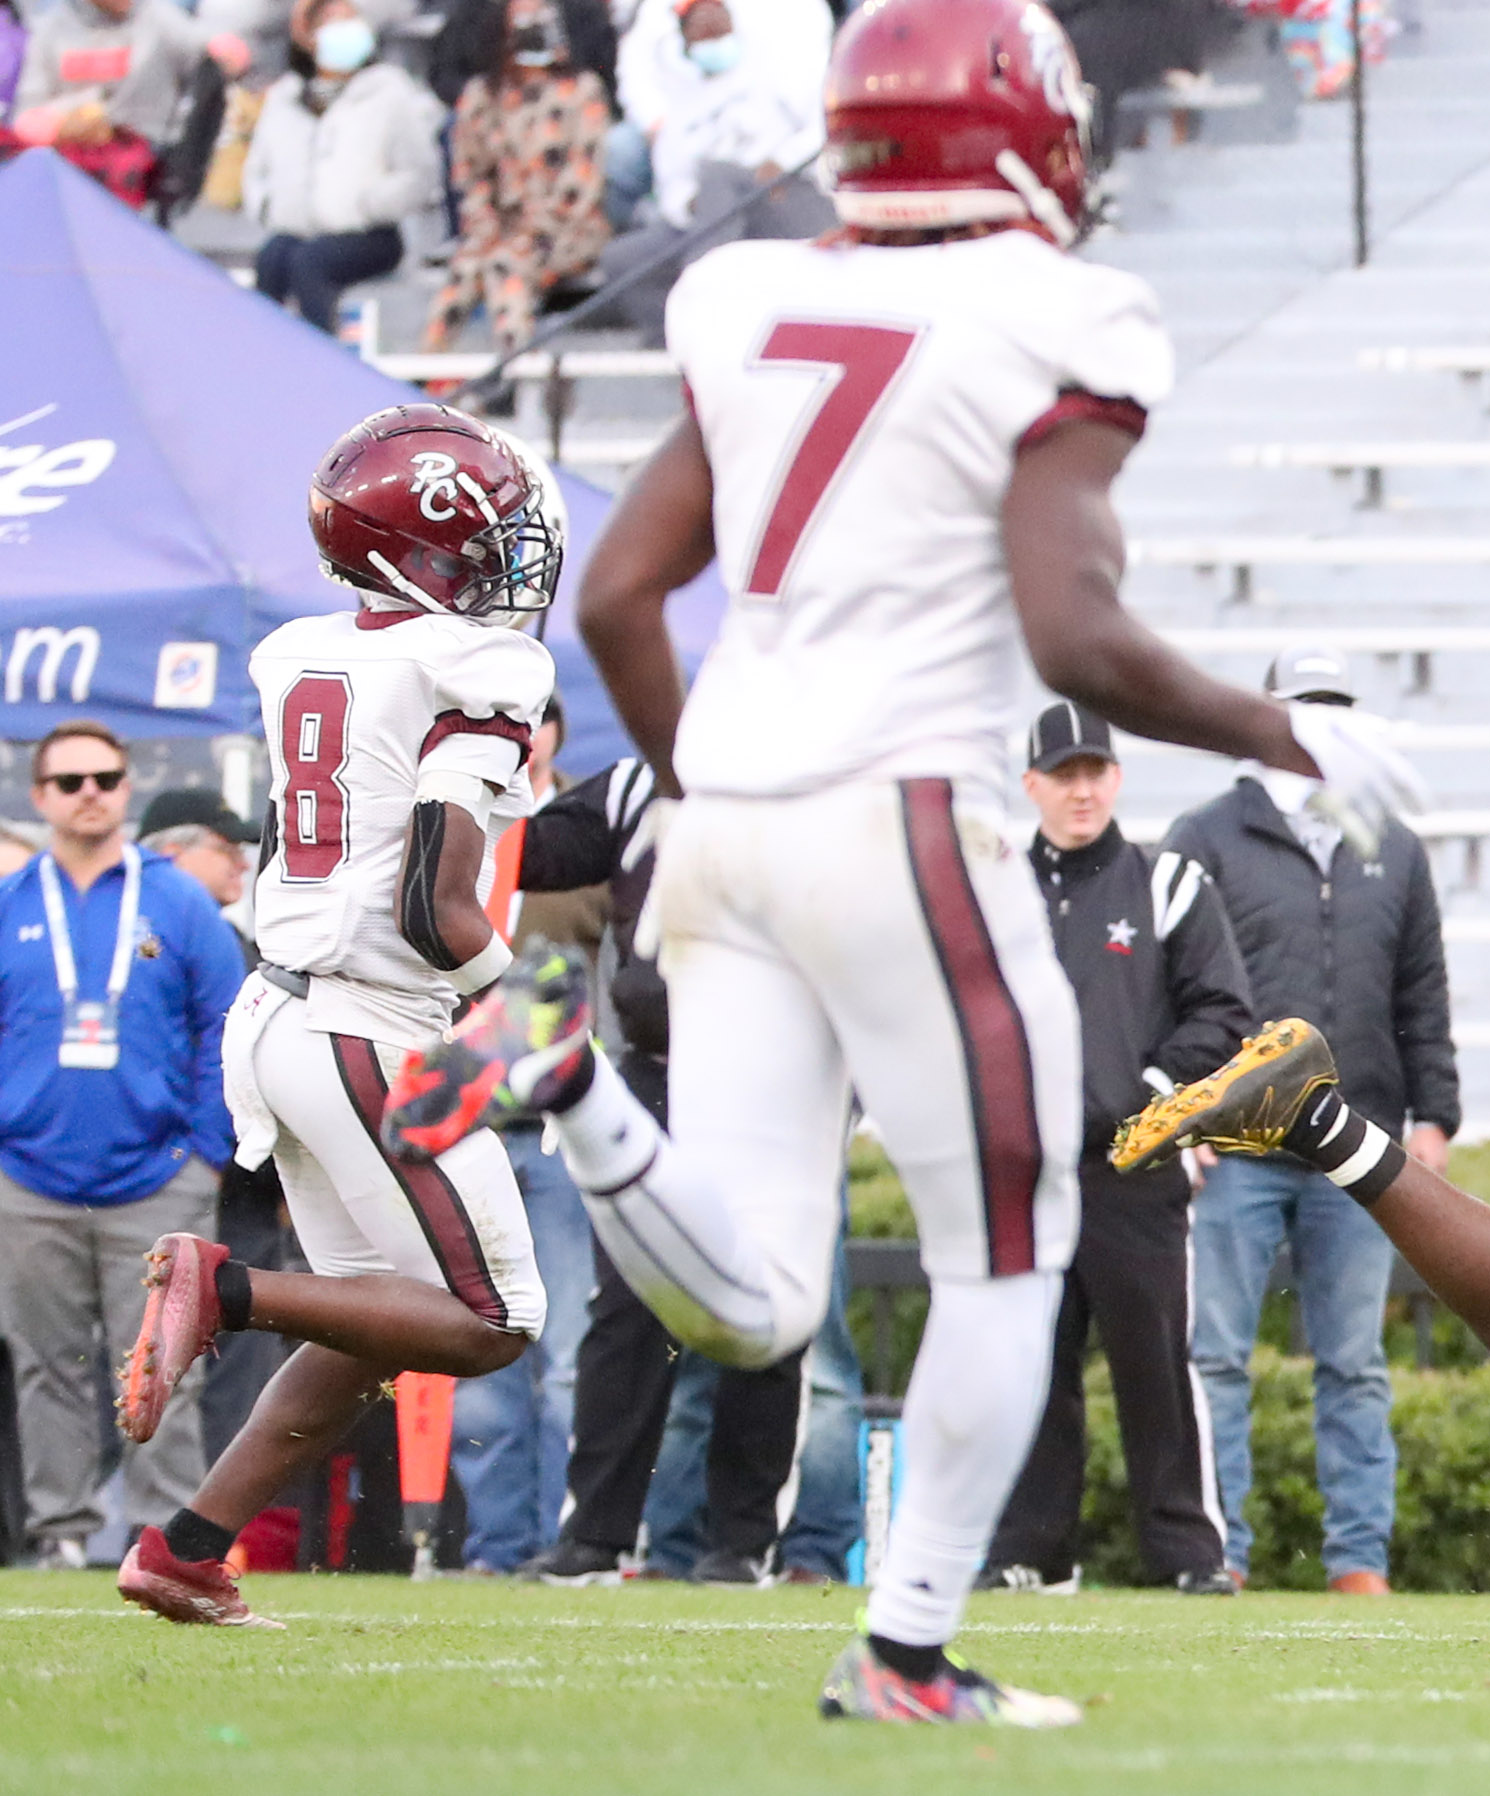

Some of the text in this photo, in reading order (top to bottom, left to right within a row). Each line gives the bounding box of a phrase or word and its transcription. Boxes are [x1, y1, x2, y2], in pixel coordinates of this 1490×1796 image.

[409, 451, 459, 522] PC
[745, 318, 924, 600] 7
[278, 670, 354, 884] 8
